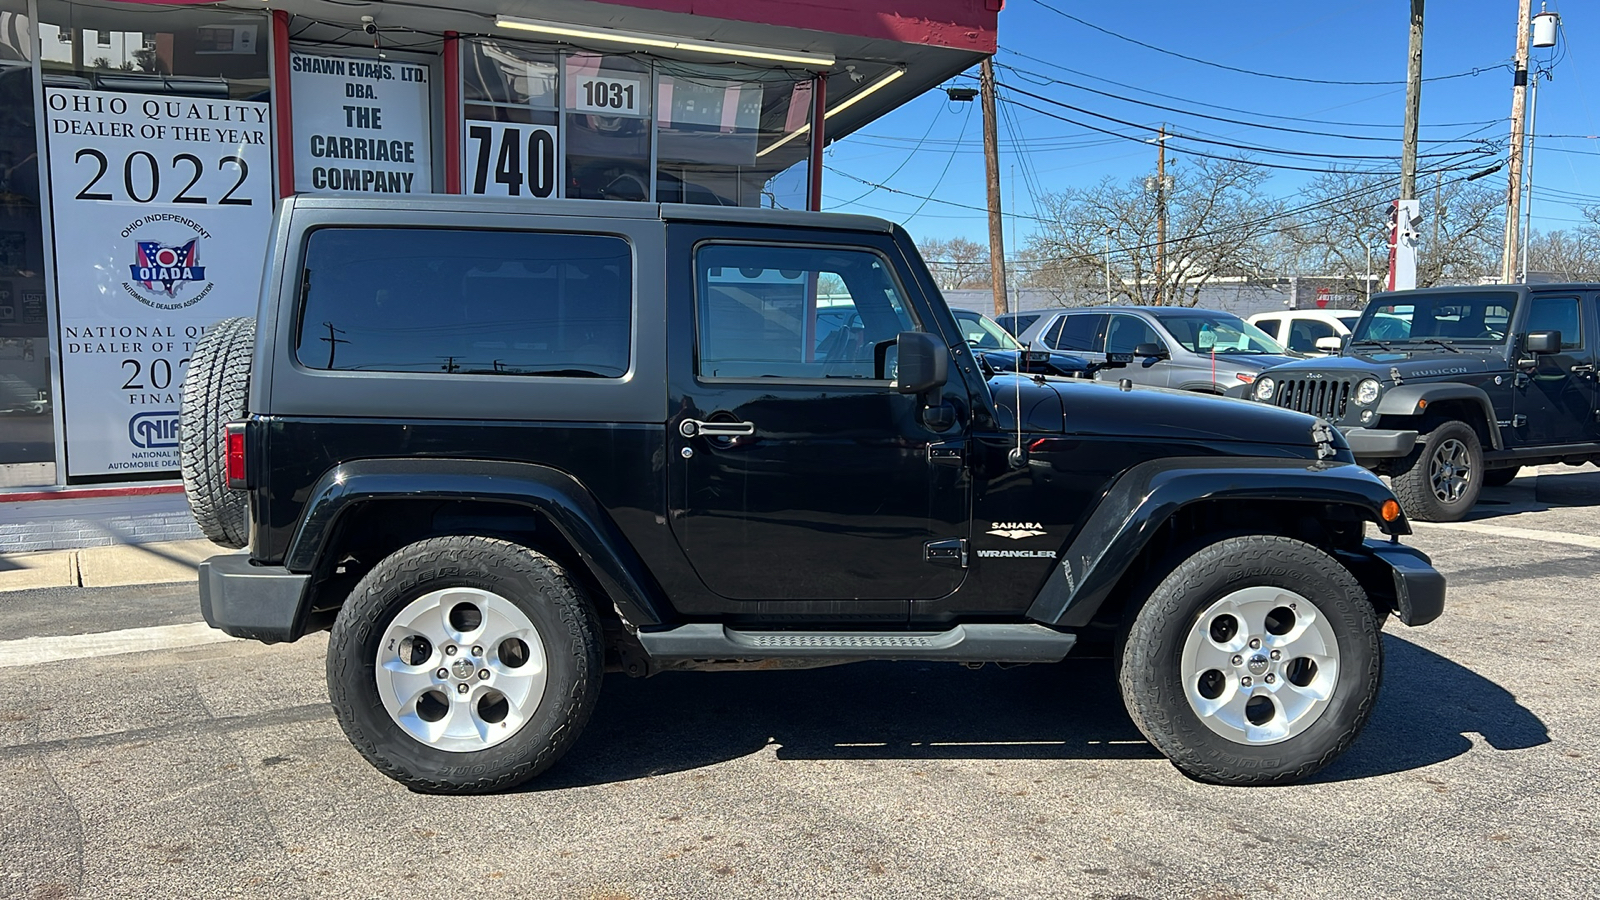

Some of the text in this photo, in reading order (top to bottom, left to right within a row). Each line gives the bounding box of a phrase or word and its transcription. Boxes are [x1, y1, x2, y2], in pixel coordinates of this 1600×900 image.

[292, 56, 345, 76] SHAWN
[401, 66, 427, 83] LTD.
[345, 83, 378, 99] DBA.
[583, 81, 634, 109] 1031
[49, 93, 267, 124] OHIO QUALITY
[343, 105, 382, 130] THE
[53, 119, 265, 145] DEALER OF THE YEAR
[310, 134, 415, 164] CARRIAGE
[469, 125, 554, 198] 740
[74, 148, 253, 206] 2022
[312, 166, 414, 194] COMPANY
[121, 213, 212, 240] OHIO INDEPENDENT
[139, 267, 194, 280] OIADA
[122, 282, 155, 308] AUTOMOBILE
[184, 282, 215, 308] ASSOCIATION
[65, 326, 176, 338] NATIONAL
[69, 342, 143, 353] DEALER
[152, 342, 174, 352] OF
[1411, 367, 1468, 377] RUBICON
[107, 460, 159, 470] AUTOMOBILE
[131, 451, 171, 459] NATIONAL
[976, 550, 1057, 559] WRANGLER
